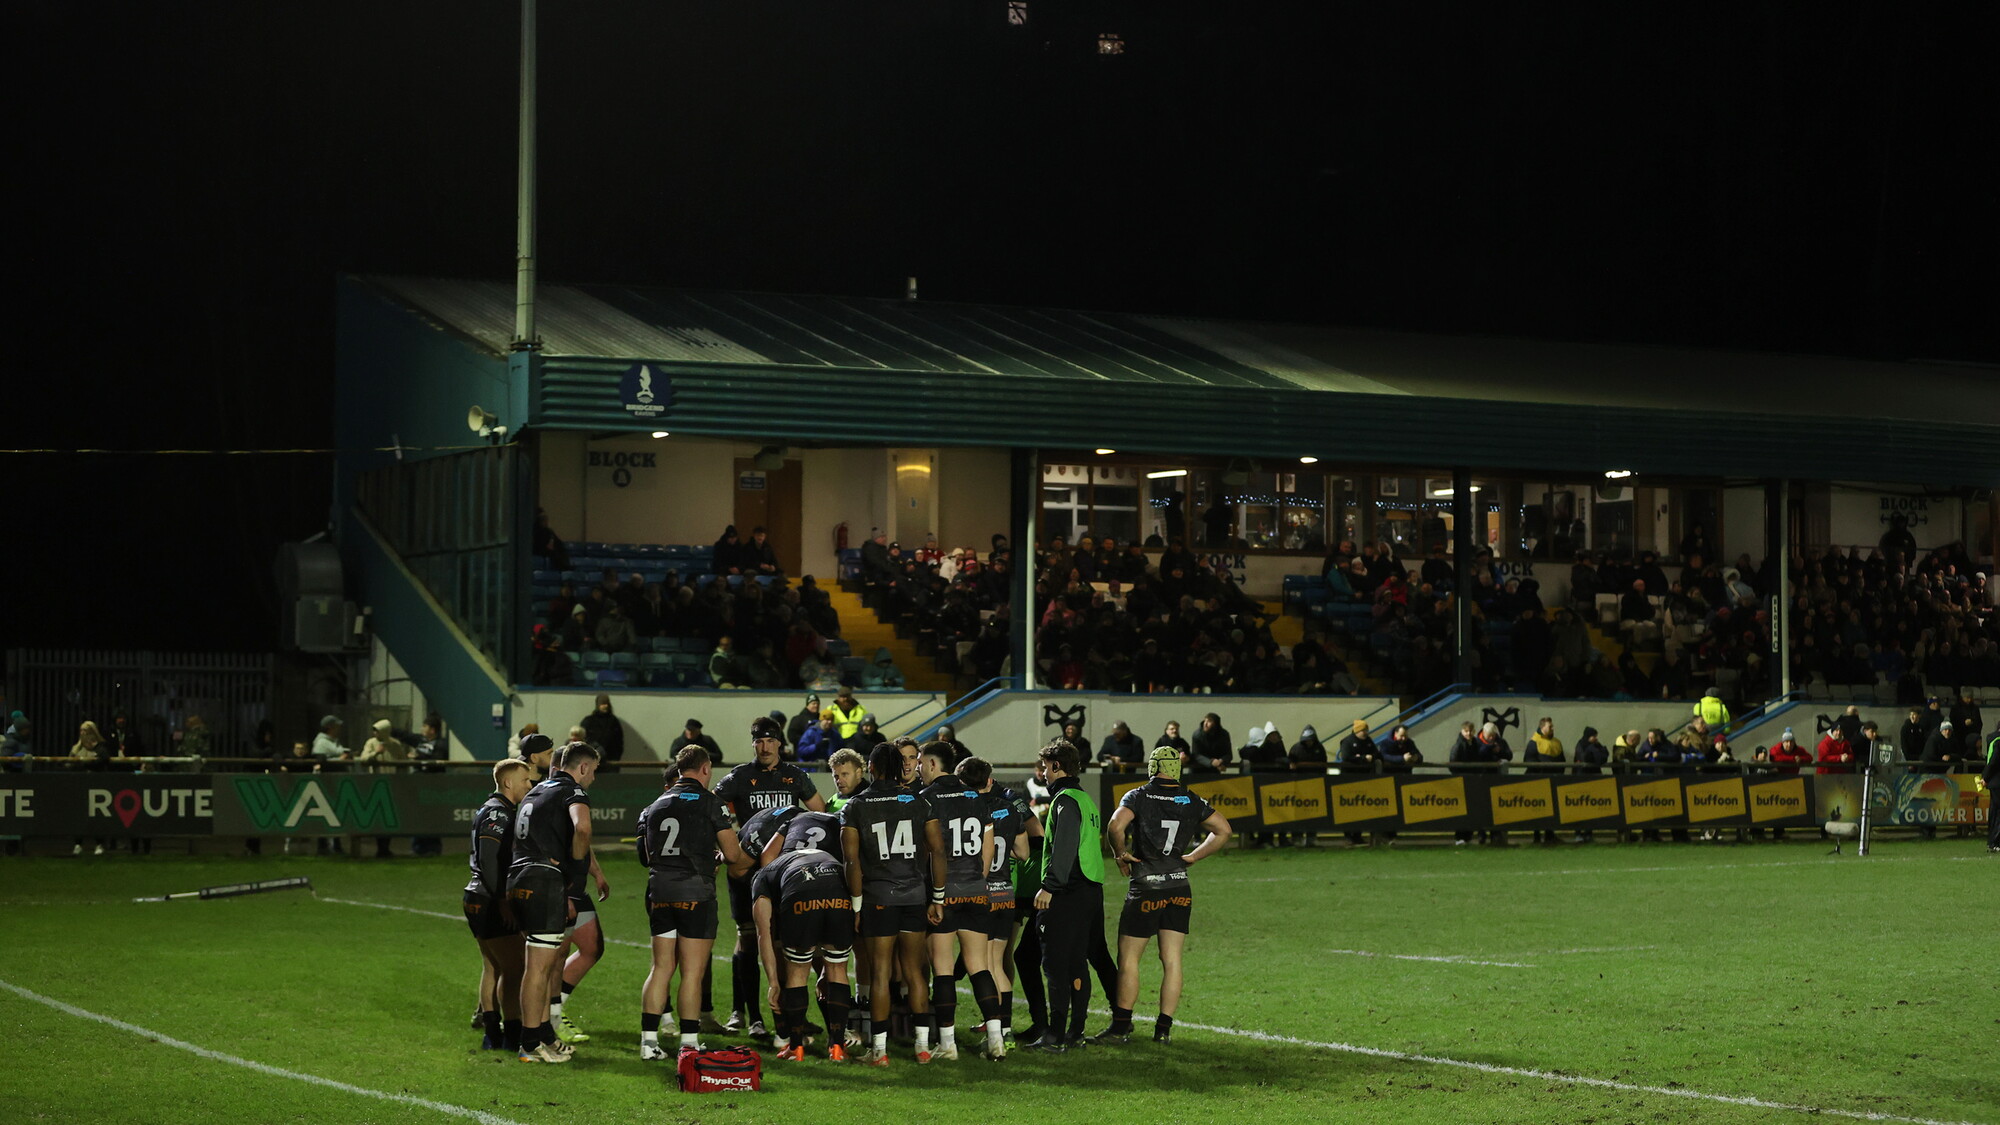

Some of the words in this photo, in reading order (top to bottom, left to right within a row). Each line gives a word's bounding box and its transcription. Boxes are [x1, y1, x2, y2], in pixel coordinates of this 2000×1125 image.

[589, 451, 656, 467] BLOCK
[1881, 496, 1928, 510] BLOCK
[1209, 553, 1246, 568] OCK
[1500, 560, 1533, 576] OCK
[234, 778, 398, 829] WAM
[750, 794, 792, 809] PRAVHA
[1208, 793, 1247, 806] ffoon
[1269, 795, 1319, 808] buffoon
[1339, 794, 1389, 807] buffoon
[1409, 794, 1459, 807] buffoon
[1498, 795, 1546, 808] buffoon
[1565, 794, 1612, 807] buffoon
[1630, 795, 1675, 807] buffoon
[1694, 794, 1738, 806] buffoon
[1756, 794, 1799, 806] buffoon
[88, 788, 213, 828] ROUTE
[1904, 807, 1967, 823] GOWER
[516, 803, 533, 839] 6
[660, 817, 681, 857] 2
[795, 827, 827, 849] 3
[872, 819, 916, 860] 14
[949, 817, 982, 857] 13
[1161, 819, 1180, 855] 7
